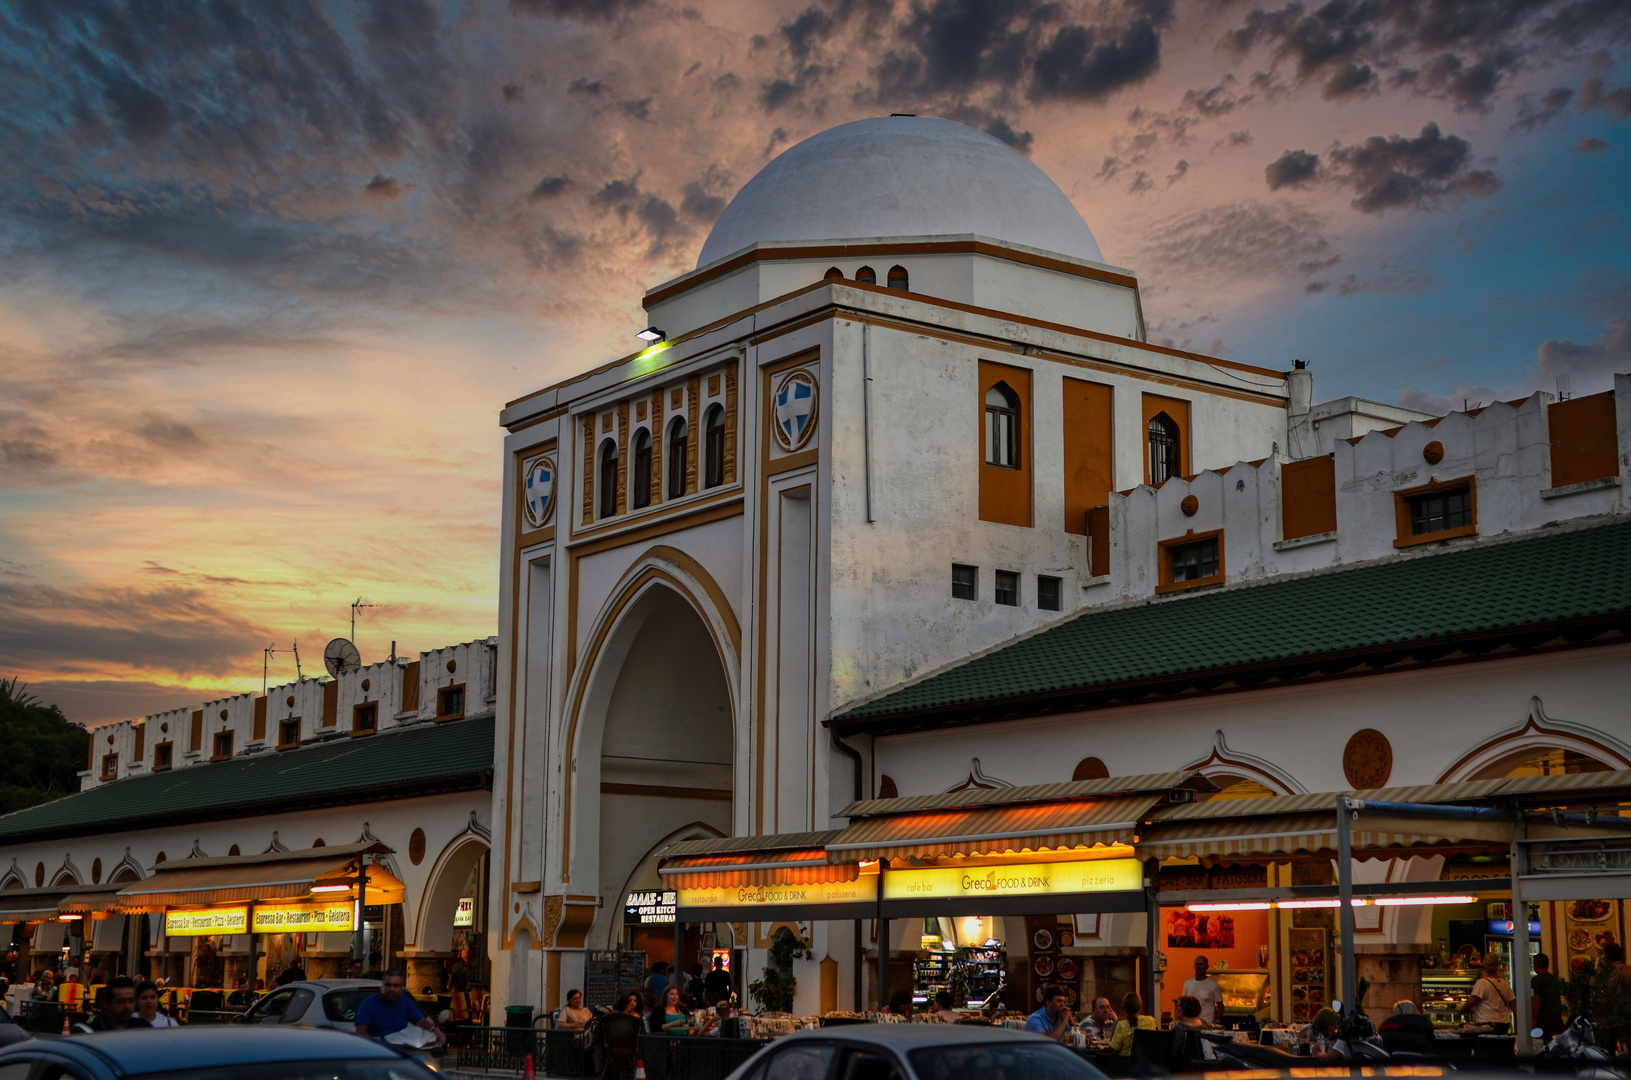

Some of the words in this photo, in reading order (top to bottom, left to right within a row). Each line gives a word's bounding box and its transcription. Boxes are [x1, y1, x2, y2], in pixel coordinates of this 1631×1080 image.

[961, 875, 991, 889] Greco
[996, 877, 1019, 888] FOOD
[1020, 877, 1026, 888] &
[1028, 876, 1050, 888] DRINK
[1081, 876, 1115, 888] pizzeria
[1186, 874, 1204, 885] BAR
[906, 883, 921, 893] cafe
[922, 882, 933, 892] bar
[691, 895, 718, 903] restaurant
[737, 888, 761, 902] Greco
[765, 891, 782, 901] FOOD
[783, 891, 789, 900] &
[789, 890, 807, 900] DRINK
[827, 890, 856, 900] patisserie
[638, 906, 655, 915] OPEN
[656, 905, 676, 914] KITCH
[640, 914, 676, 923] RESTAURA
